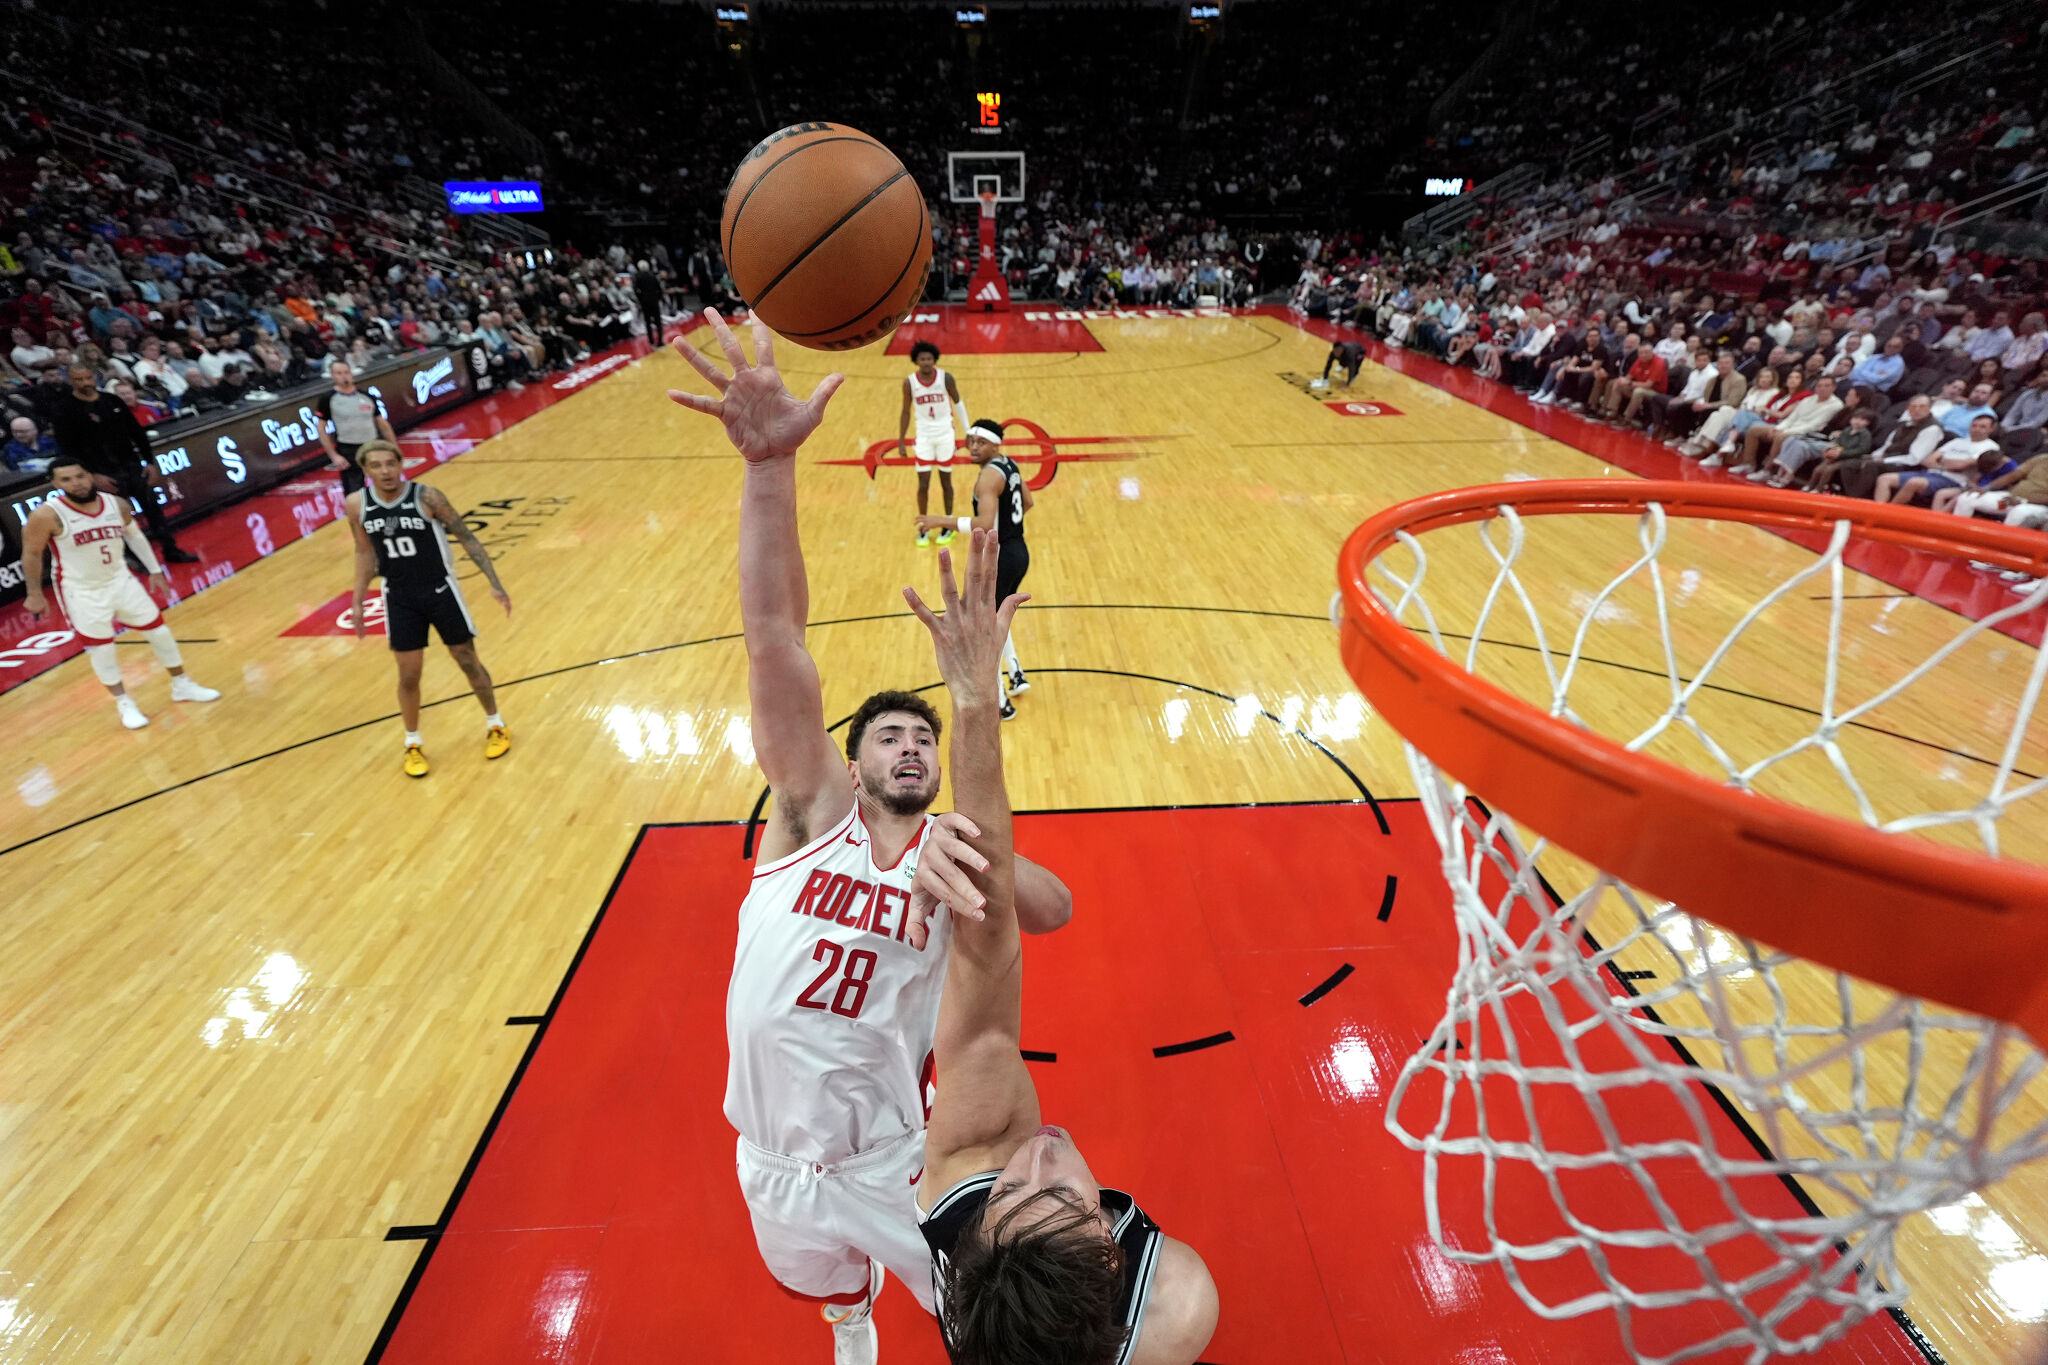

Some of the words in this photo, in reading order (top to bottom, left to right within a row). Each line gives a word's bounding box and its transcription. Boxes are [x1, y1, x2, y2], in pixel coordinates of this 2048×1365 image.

[980, 104, 999, 126] 15
[499, 189, 539, 204] ULTRA
[928, 406, 936, 420] 4
[261, 418, 305, 455] Sire
[1011, 490, 1024, 525] 3
[99, 545, 113, 565] 5
[383, 536, 417, 559] 10
[795, 938, 878, 1019] 28
